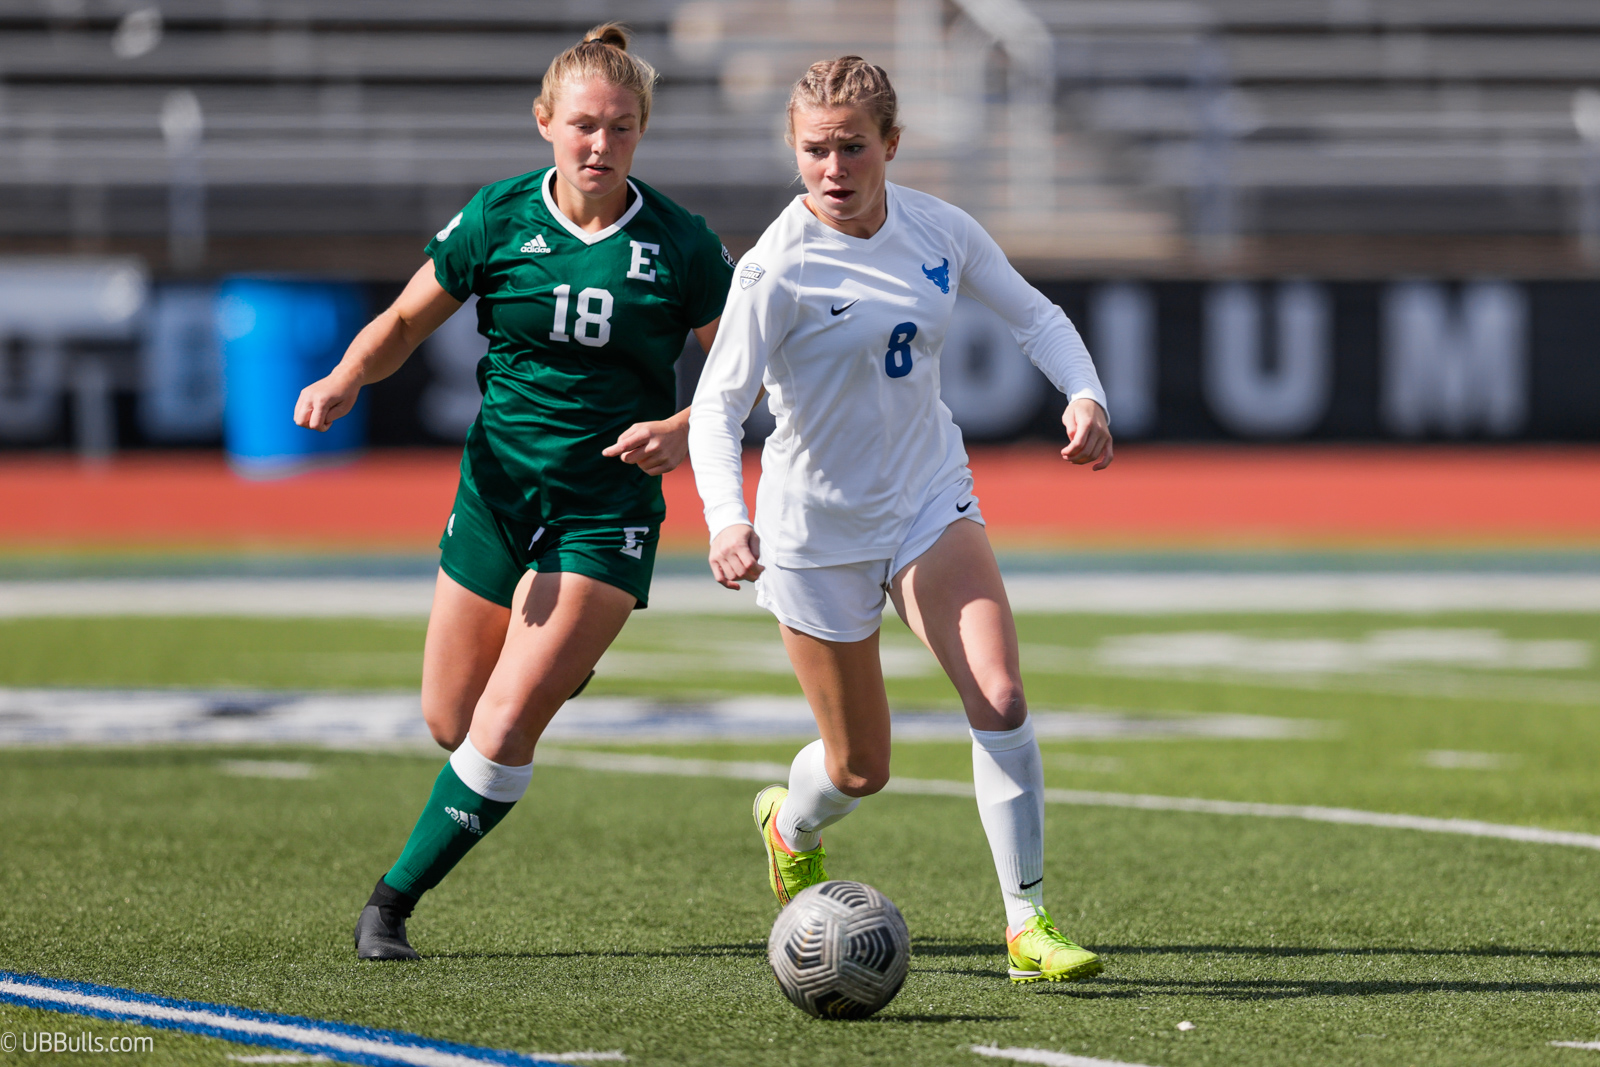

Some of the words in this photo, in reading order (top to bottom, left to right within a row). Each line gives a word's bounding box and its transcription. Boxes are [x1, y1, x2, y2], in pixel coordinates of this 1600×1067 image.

[520, 245, 551, 253] adidas
[626, 240, 660, 282] E
[549, 283, 615, 347] 18
[885, 321, 918, 379] 8
[444, 806, 484, 836] adidas
